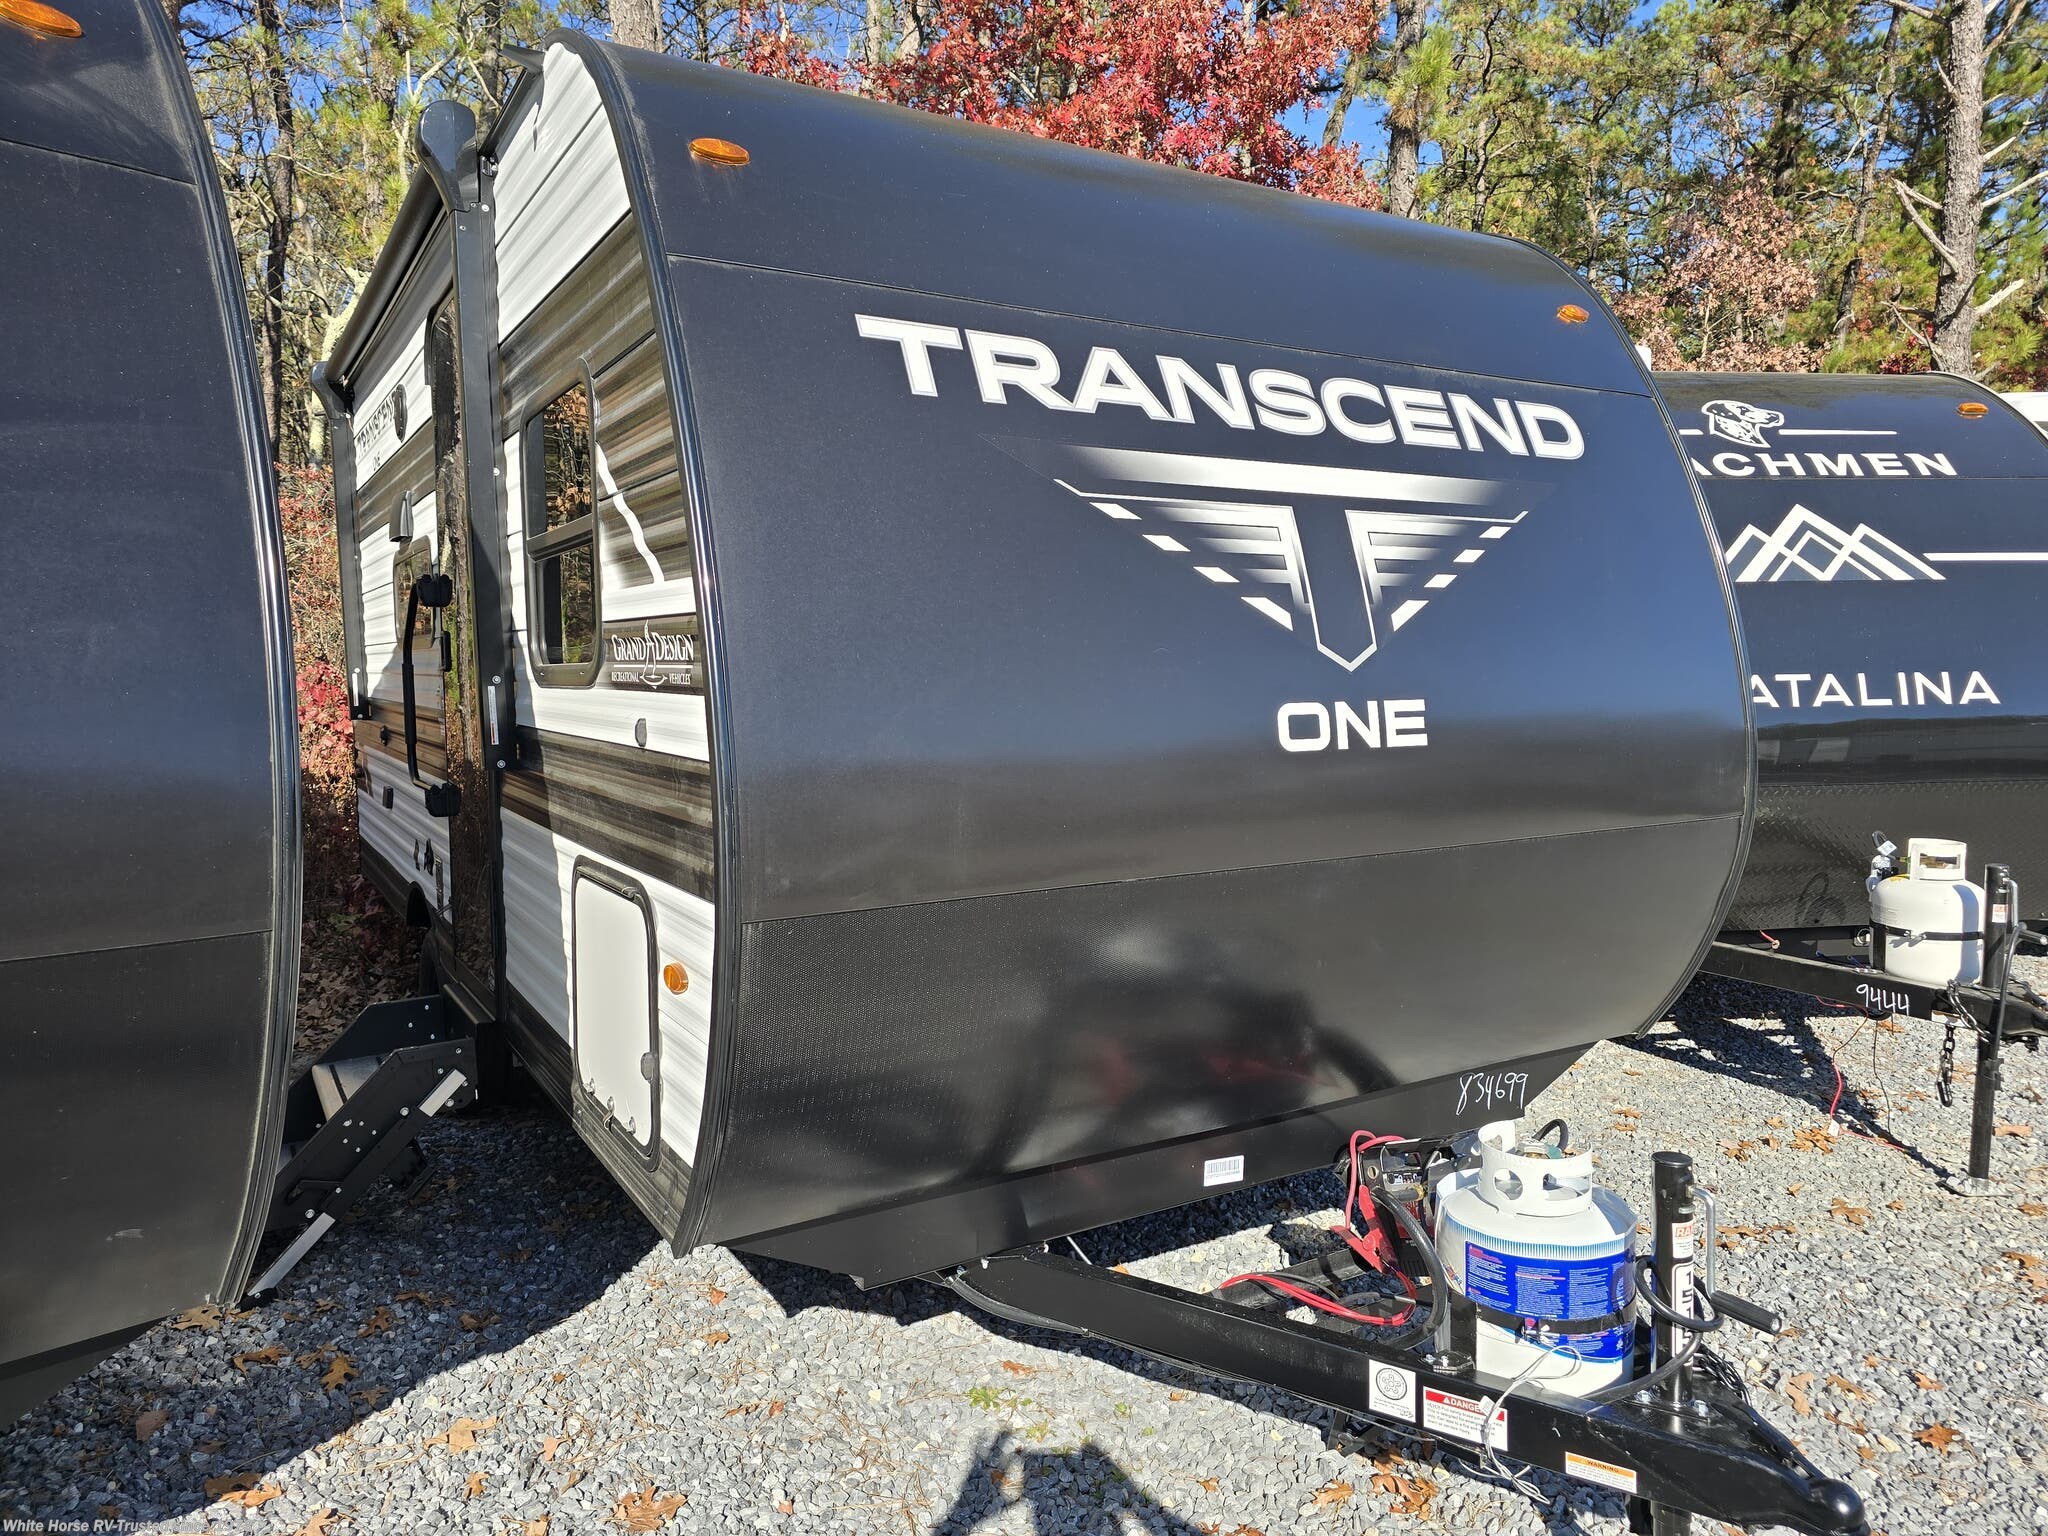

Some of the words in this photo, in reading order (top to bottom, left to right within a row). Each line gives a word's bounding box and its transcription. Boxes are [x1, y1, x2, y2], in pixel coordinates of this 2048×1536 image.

[854, 313, 1586, 462] TRANSCEND
[357, 395, 396, 457] TRANSCEN
[611, 634, 646, 661] GRAND
[651, 632, 694, 661] DESIGN
[1750, 671, 2001, 708] ATALINA
[1276, 699, 1429, 752] ONE
[1856, 983, 1910, 1016] 9444
[1456, 1072, 1529, 1116] 834699
[1450, 1398, 1481, 1413] DANGE
[1587, 1459, 1619, 1473] WARNING
